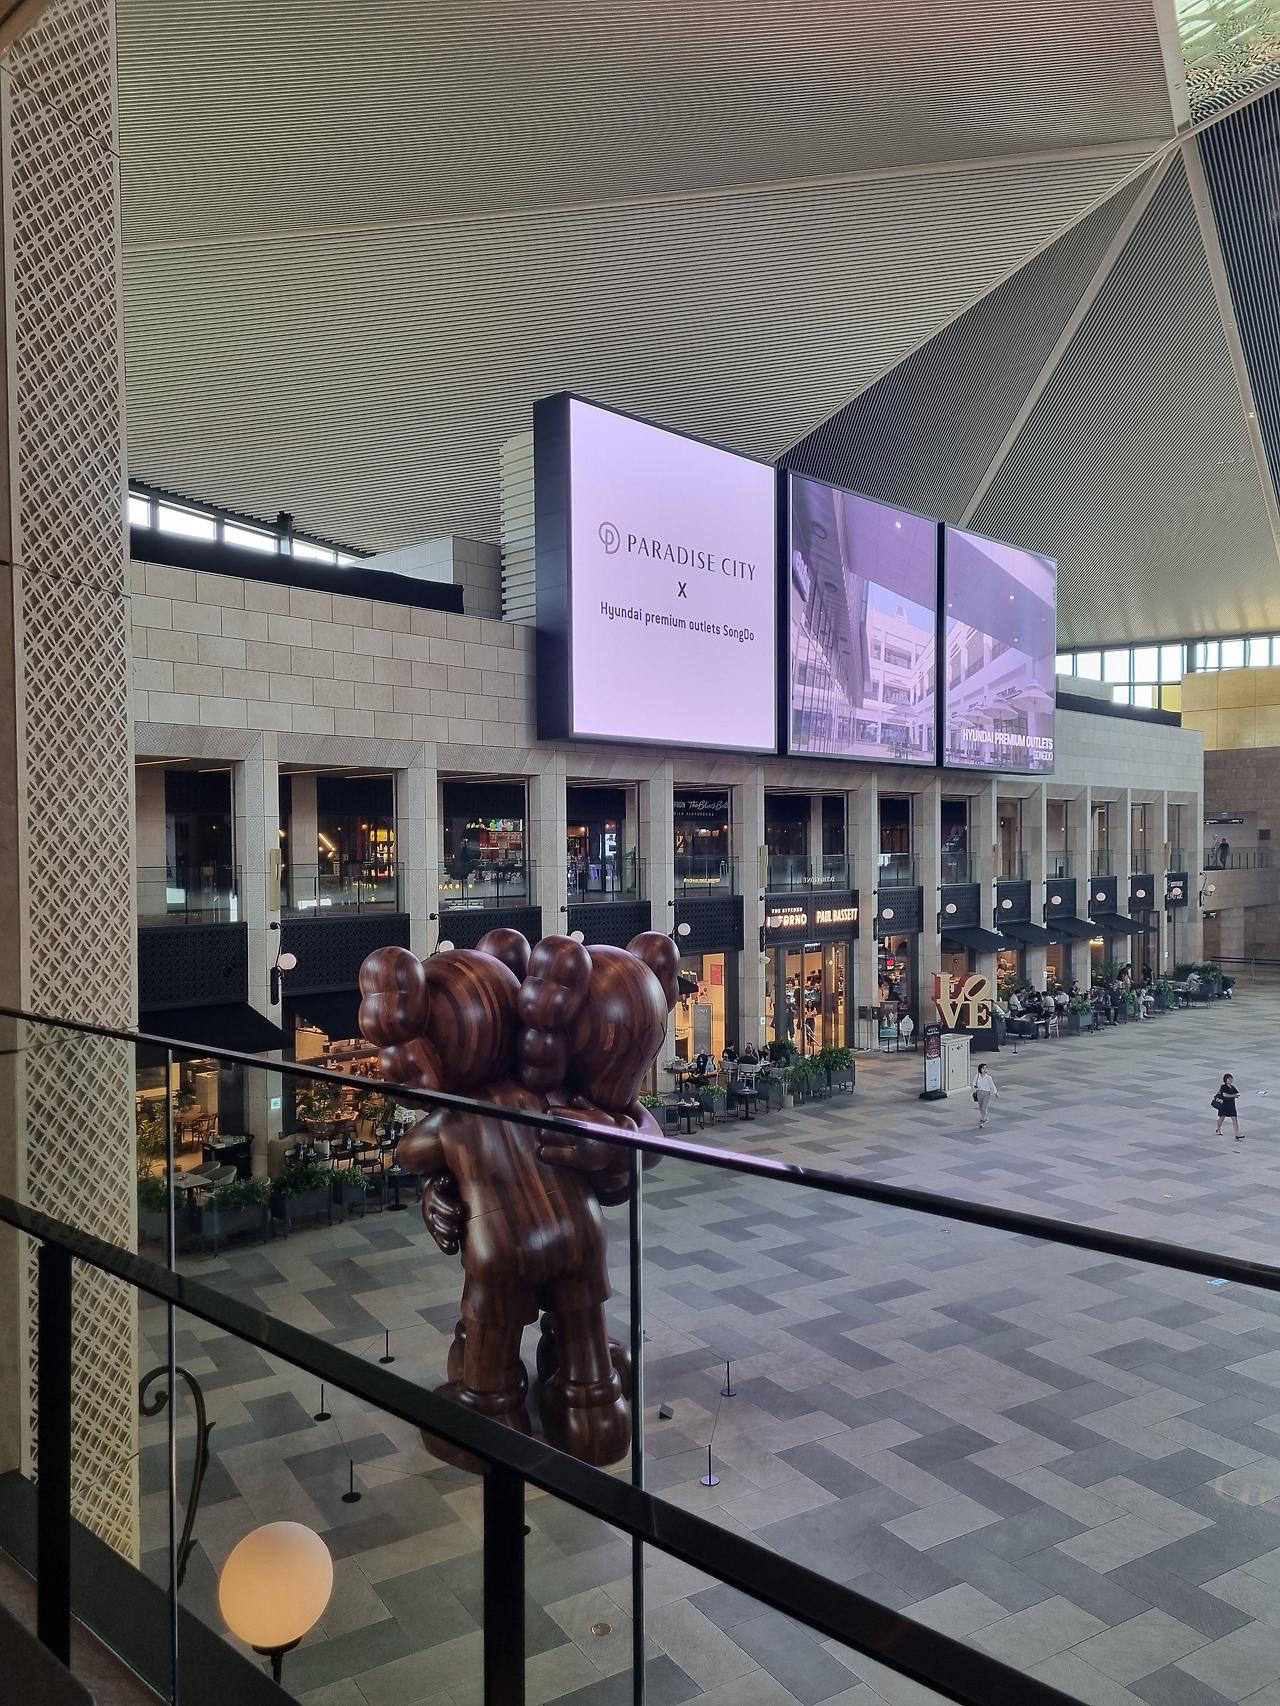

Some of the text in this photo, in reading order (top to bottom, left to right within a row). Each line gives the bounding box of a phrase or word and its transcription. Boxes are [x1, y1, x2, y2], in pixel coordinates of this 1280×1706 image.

[627, 533, 756, 581] PARADISE CITY
[677, 581, 688, 599] X
[600, 601, 755, 643] Hyundai premium outlets SongDo
[963, 728, 1054, 750] HYUNDAI PREMIUM OUTLETS
[816, 908, 858, 923] PAUL BASSETT
